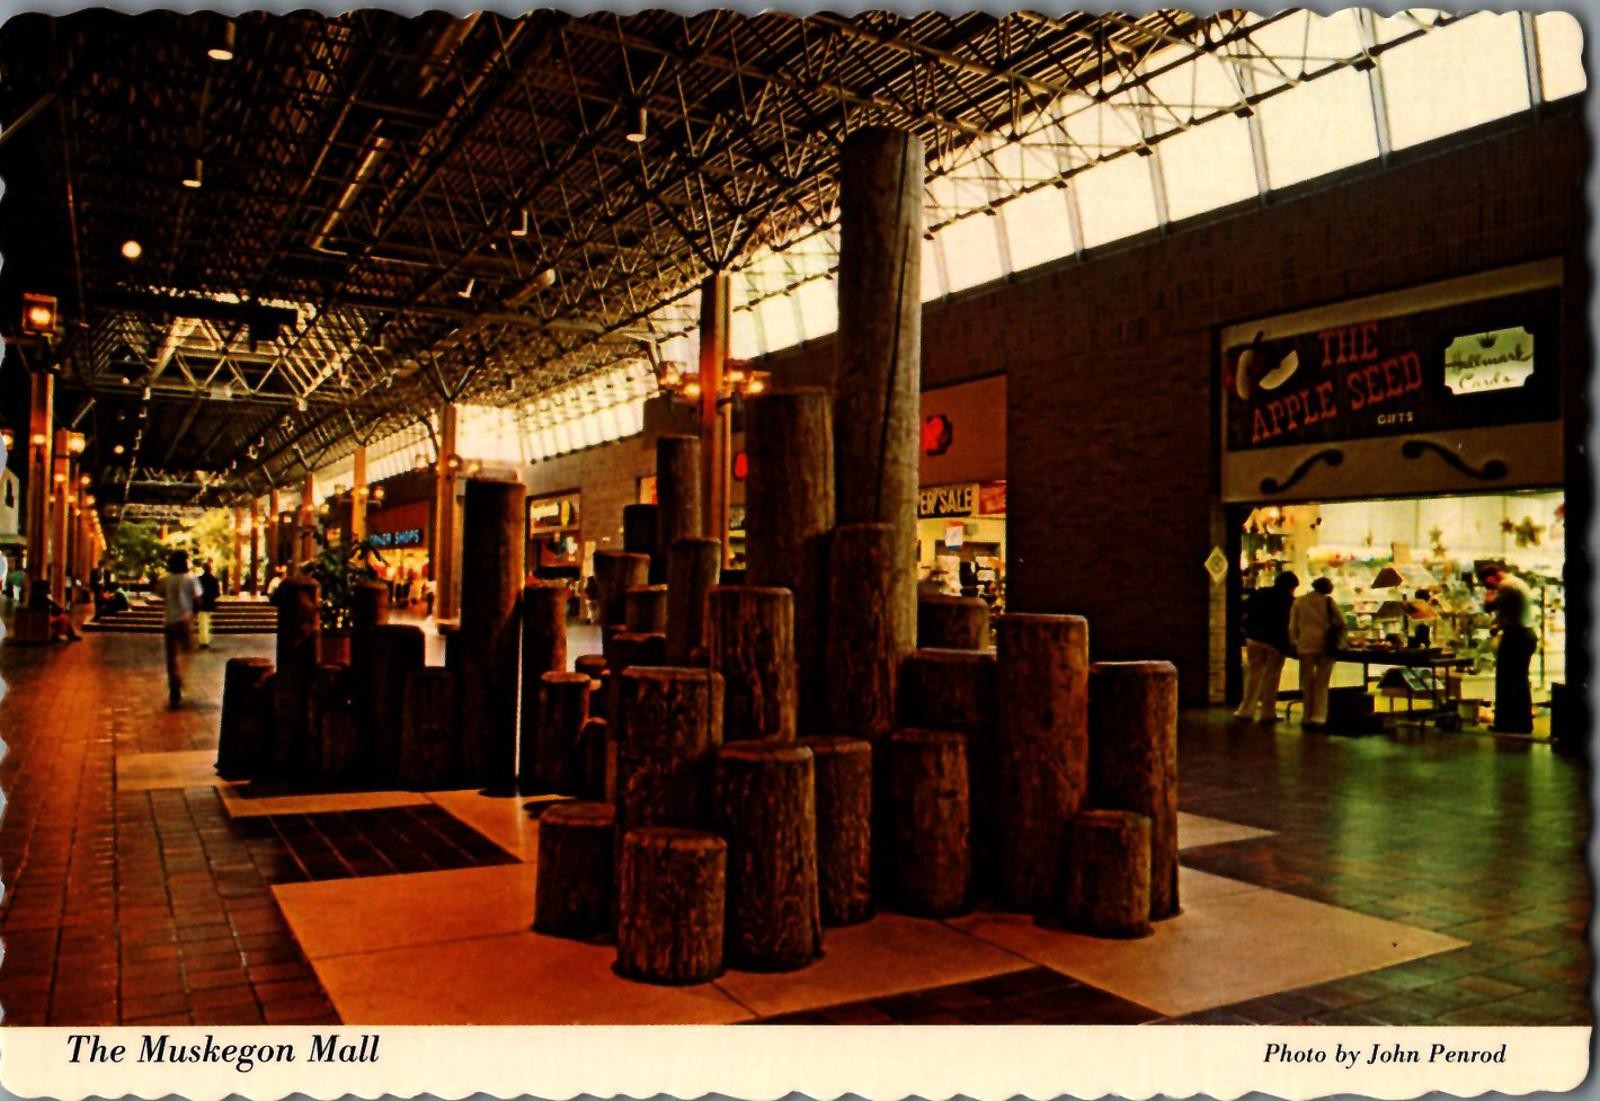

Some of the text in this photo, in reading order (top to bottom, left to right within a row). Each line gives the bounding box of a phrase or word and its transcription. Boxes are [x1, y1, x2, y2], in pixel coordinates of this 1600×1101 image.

[1318, 321, 1380, 368] THE
[1445, 343, 1533, 370] Hallmark
[1251, 351, 1424, 444] APPLE SEED
[1377, 410, 1414, 425] GIFTS
[939, 485, 973, 514] SALE
